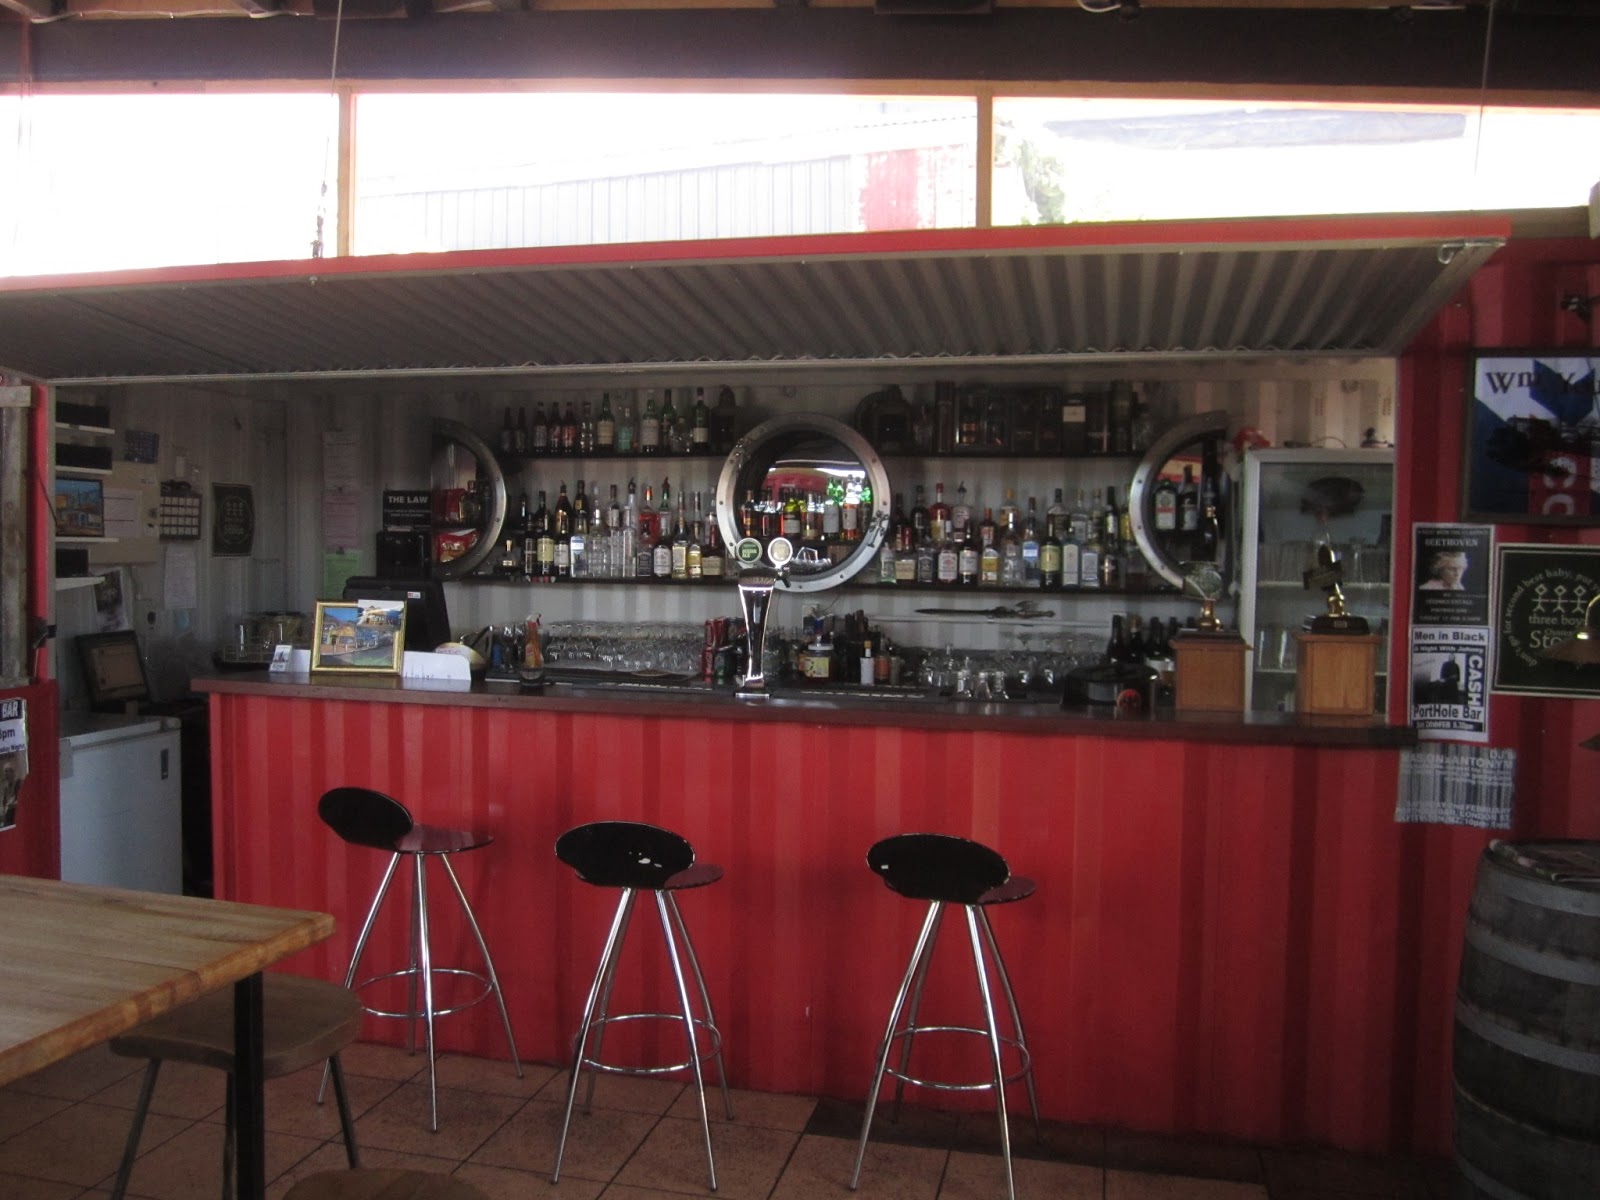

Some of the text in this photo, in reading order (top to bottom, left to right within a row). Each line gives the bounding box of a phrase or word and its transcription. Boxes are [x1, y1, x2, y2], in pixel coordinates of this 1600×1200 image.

[388, 496, 429, 504] THE LAW
[1425, 538, 1478, 547] BEETHOVEN
[1505, 585, 1524, 617] second
[1522, 572, 1544, 588] best
[1528, 614, 1558, 625] three
[1414, 631, 1485, 641] Men in Black
[1467, 654, 1484, 707] CASH
[2, 701, 19, 719] BAR
[1413, 704, 1482, 720] PortHole Bar
